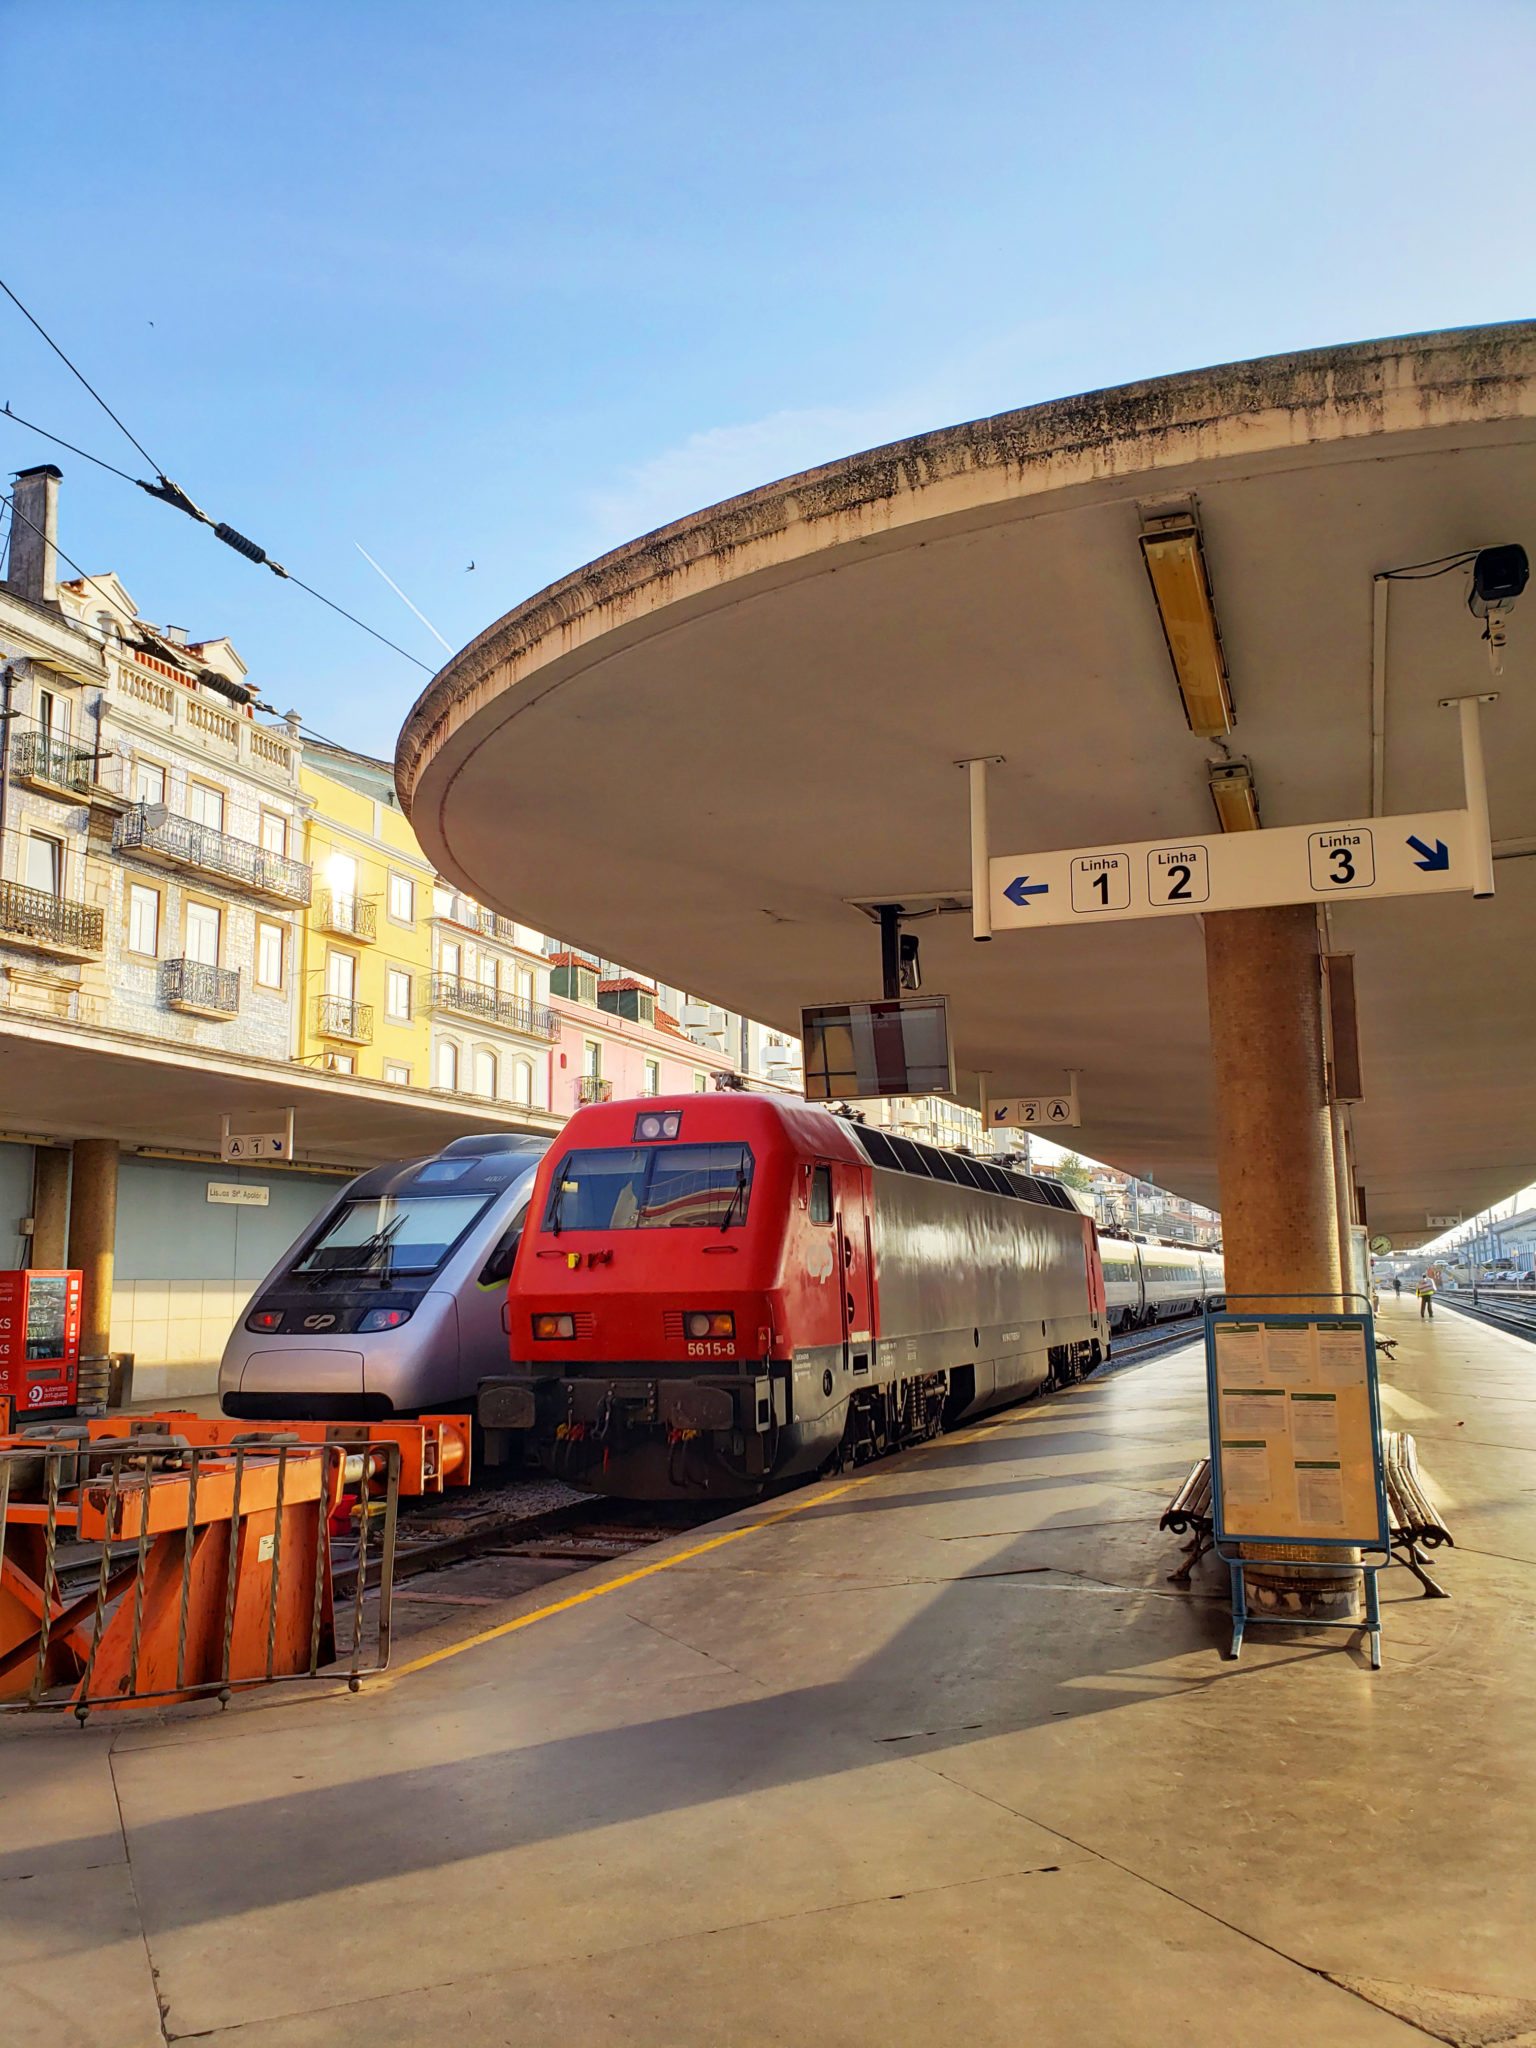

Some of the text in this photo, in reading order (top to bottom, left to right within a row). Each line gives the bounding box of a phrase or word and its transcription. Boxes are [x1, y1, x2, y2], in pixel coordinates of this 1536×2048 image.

[1319, 834, 1361, 848] Linha
[1081, 858, 1119, 872] Linha
[1157, 851, 1197, 865] Linha
[1329, 848, 1356, 885] 3
[1092, 872, 1109, 905] 1
[1167, 864, 1193, 900] 2
[1025, 1107, 1035, 1121] 2
[1052, 1104, 1065, 1118] A
[231, 1142, 241, 1153] A
[253, 1142, 259, 1154] 1
[687, 1341, 736, 1356] 5615-8
